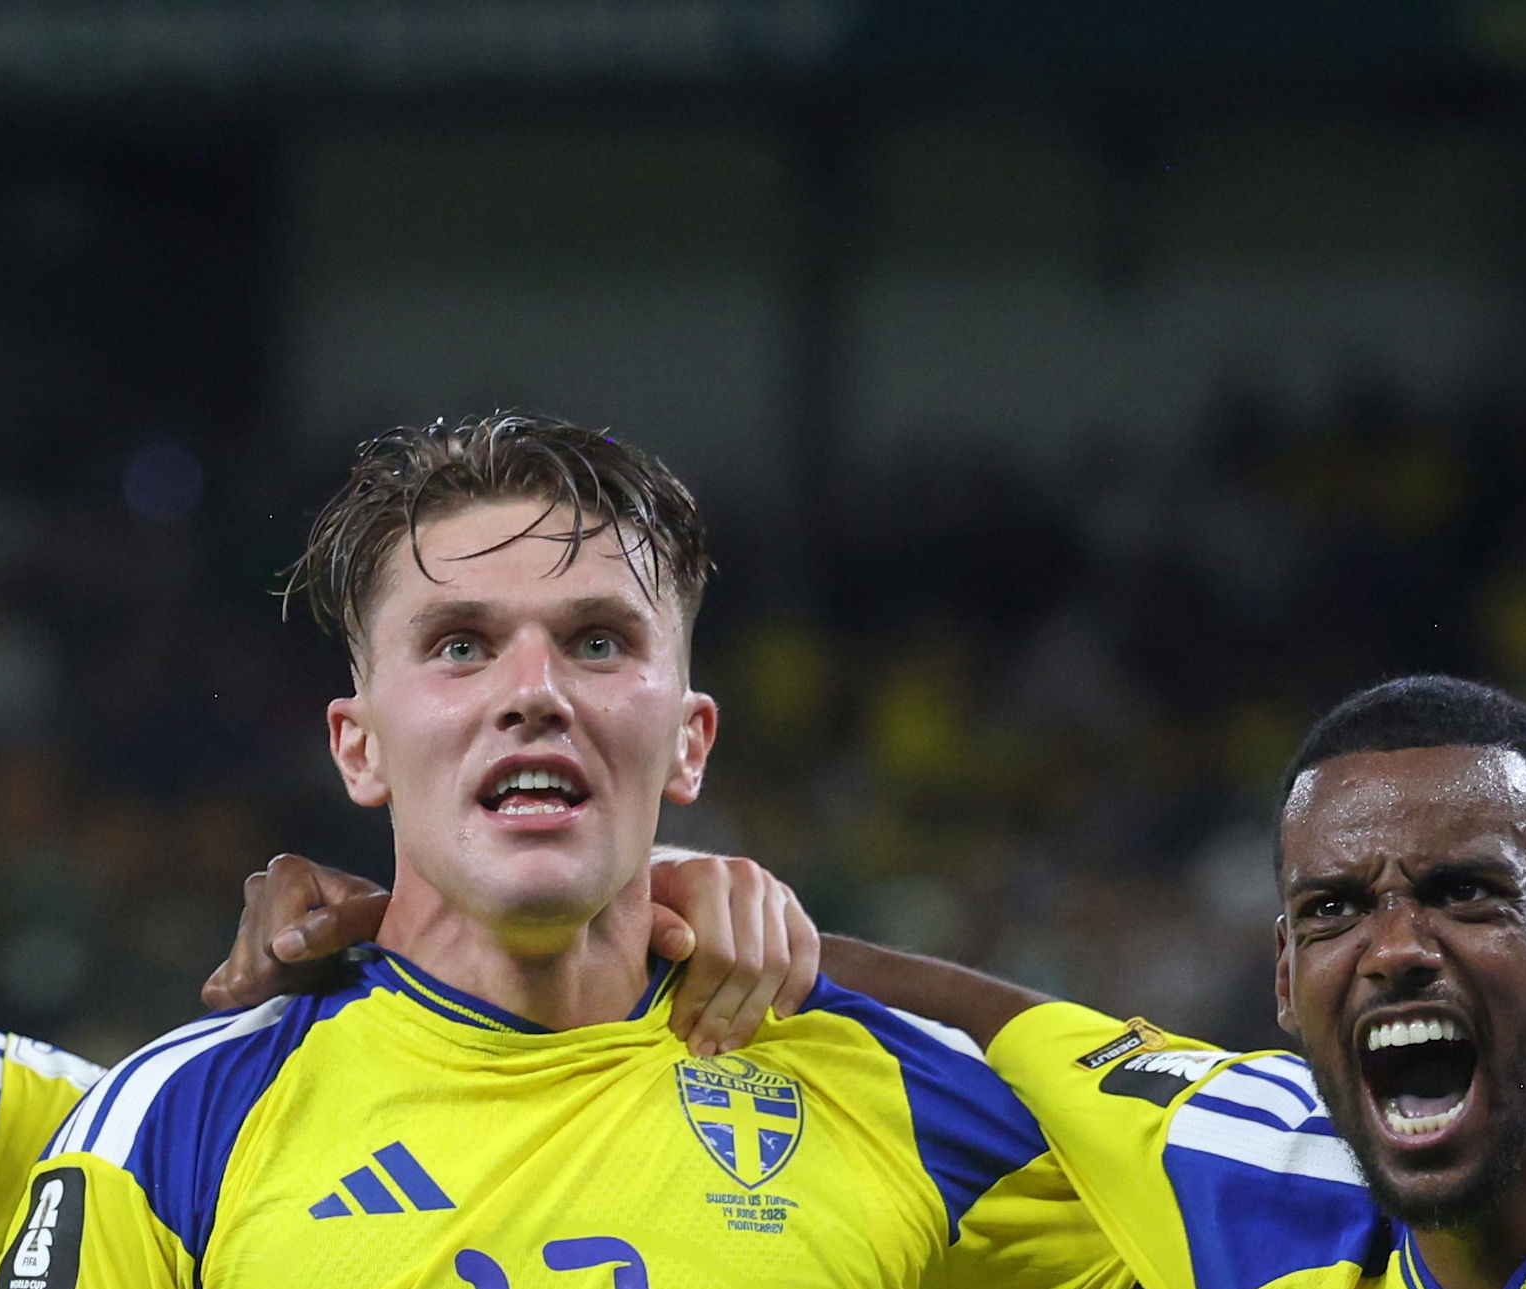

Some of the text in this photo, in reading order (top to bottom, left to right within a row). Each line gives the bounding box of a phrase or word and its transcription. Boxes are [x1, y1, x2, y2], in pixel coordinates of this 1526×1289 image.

[1090, 1037, 1141, 1068] DEBUT
[695, 1071, 781, 1097] SVERIGE
[761, 1208, 787, 1221] 2026
[22, 1256, 38, 1267] FIFA
[9, 1279, 29, 1289] WORLD
